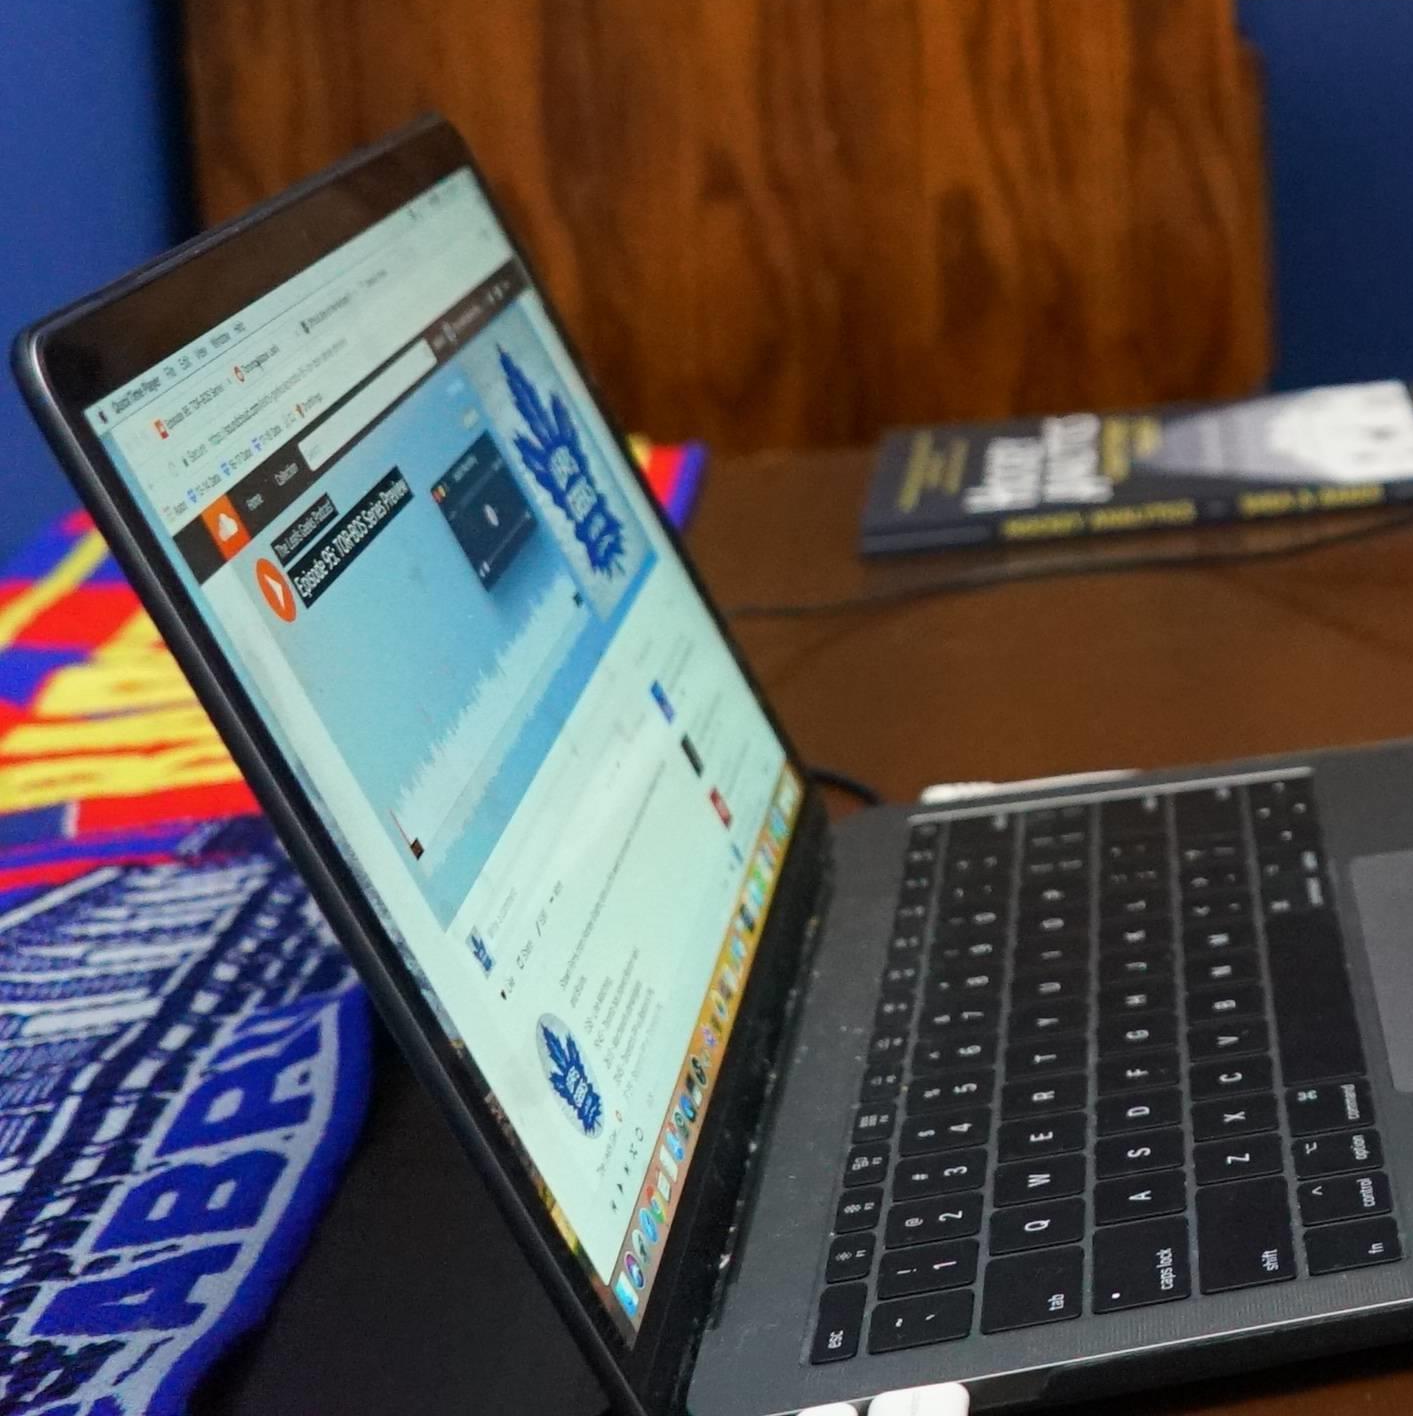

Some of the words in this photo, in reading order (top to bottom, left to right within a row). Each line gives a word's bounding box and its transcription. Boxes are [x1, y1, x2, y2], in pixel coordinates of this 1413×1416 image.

[294, 560, 327, 597] Episode
[321, 546, 340, 569] 95:
[333, 516, 367, 555] TOR-BOS
[361, 501, 386, 528] Series
[379, 479, 407, 509] Preview
[1126, 994, 1146, 1006] H
[1213, 999, 1237, 1010] B
[961, 1011, 985, 1020] 7
[1036, 1017, 1059, 1027] Y
[1125, 1029, 1150, 1041] G
[1217, 1036, 1239, 1046] V
[958, 1045, 982, 1056] 6
[1033, 1054, 1057, 1064] T
[1125, 1068, 1149, 1078] F
[1219, 1072, 1243, 1083] C
[953, 1082, 978, 1094] 5
[1031, 1090, 1055, 1102] R
[1343, 1083, 1360, 1120] command
[1126, 1105, 1150, 1118] D
[1223, 1111, 1246, 1123] X
[949, 1122, 972, 1133] 4
[1029, 1131, 1054, 1142] E
[1126, 1147, 1151, 1158] S
[1350, 1134, 1370, 1161] option
[1226, 1152, 1250, 1165] Z
[943, 1165, 968, 1177] 3
[1027, 1173, 1051, 1188] W
[1128, 1190, 1152, 1201] A
[1356, 1177, 1376, 1208] control
[938, 1210, 963, 1222] 2
[904, 1217, 924, 1228] @
[1024, 1219, 1051, 1232] Q
[1367, 1242, 1384, 1255] fn
[1156, 1247, 1173, 1267] lock
[1261, 1248, 1279, 1272] shift
[932, 1260, 957, 1270] 1
[1156, 1259, 1177, 1291] caps
[1047, 1293, 1065, 1311] tab
[827, 1329, 844, 1349] esc
